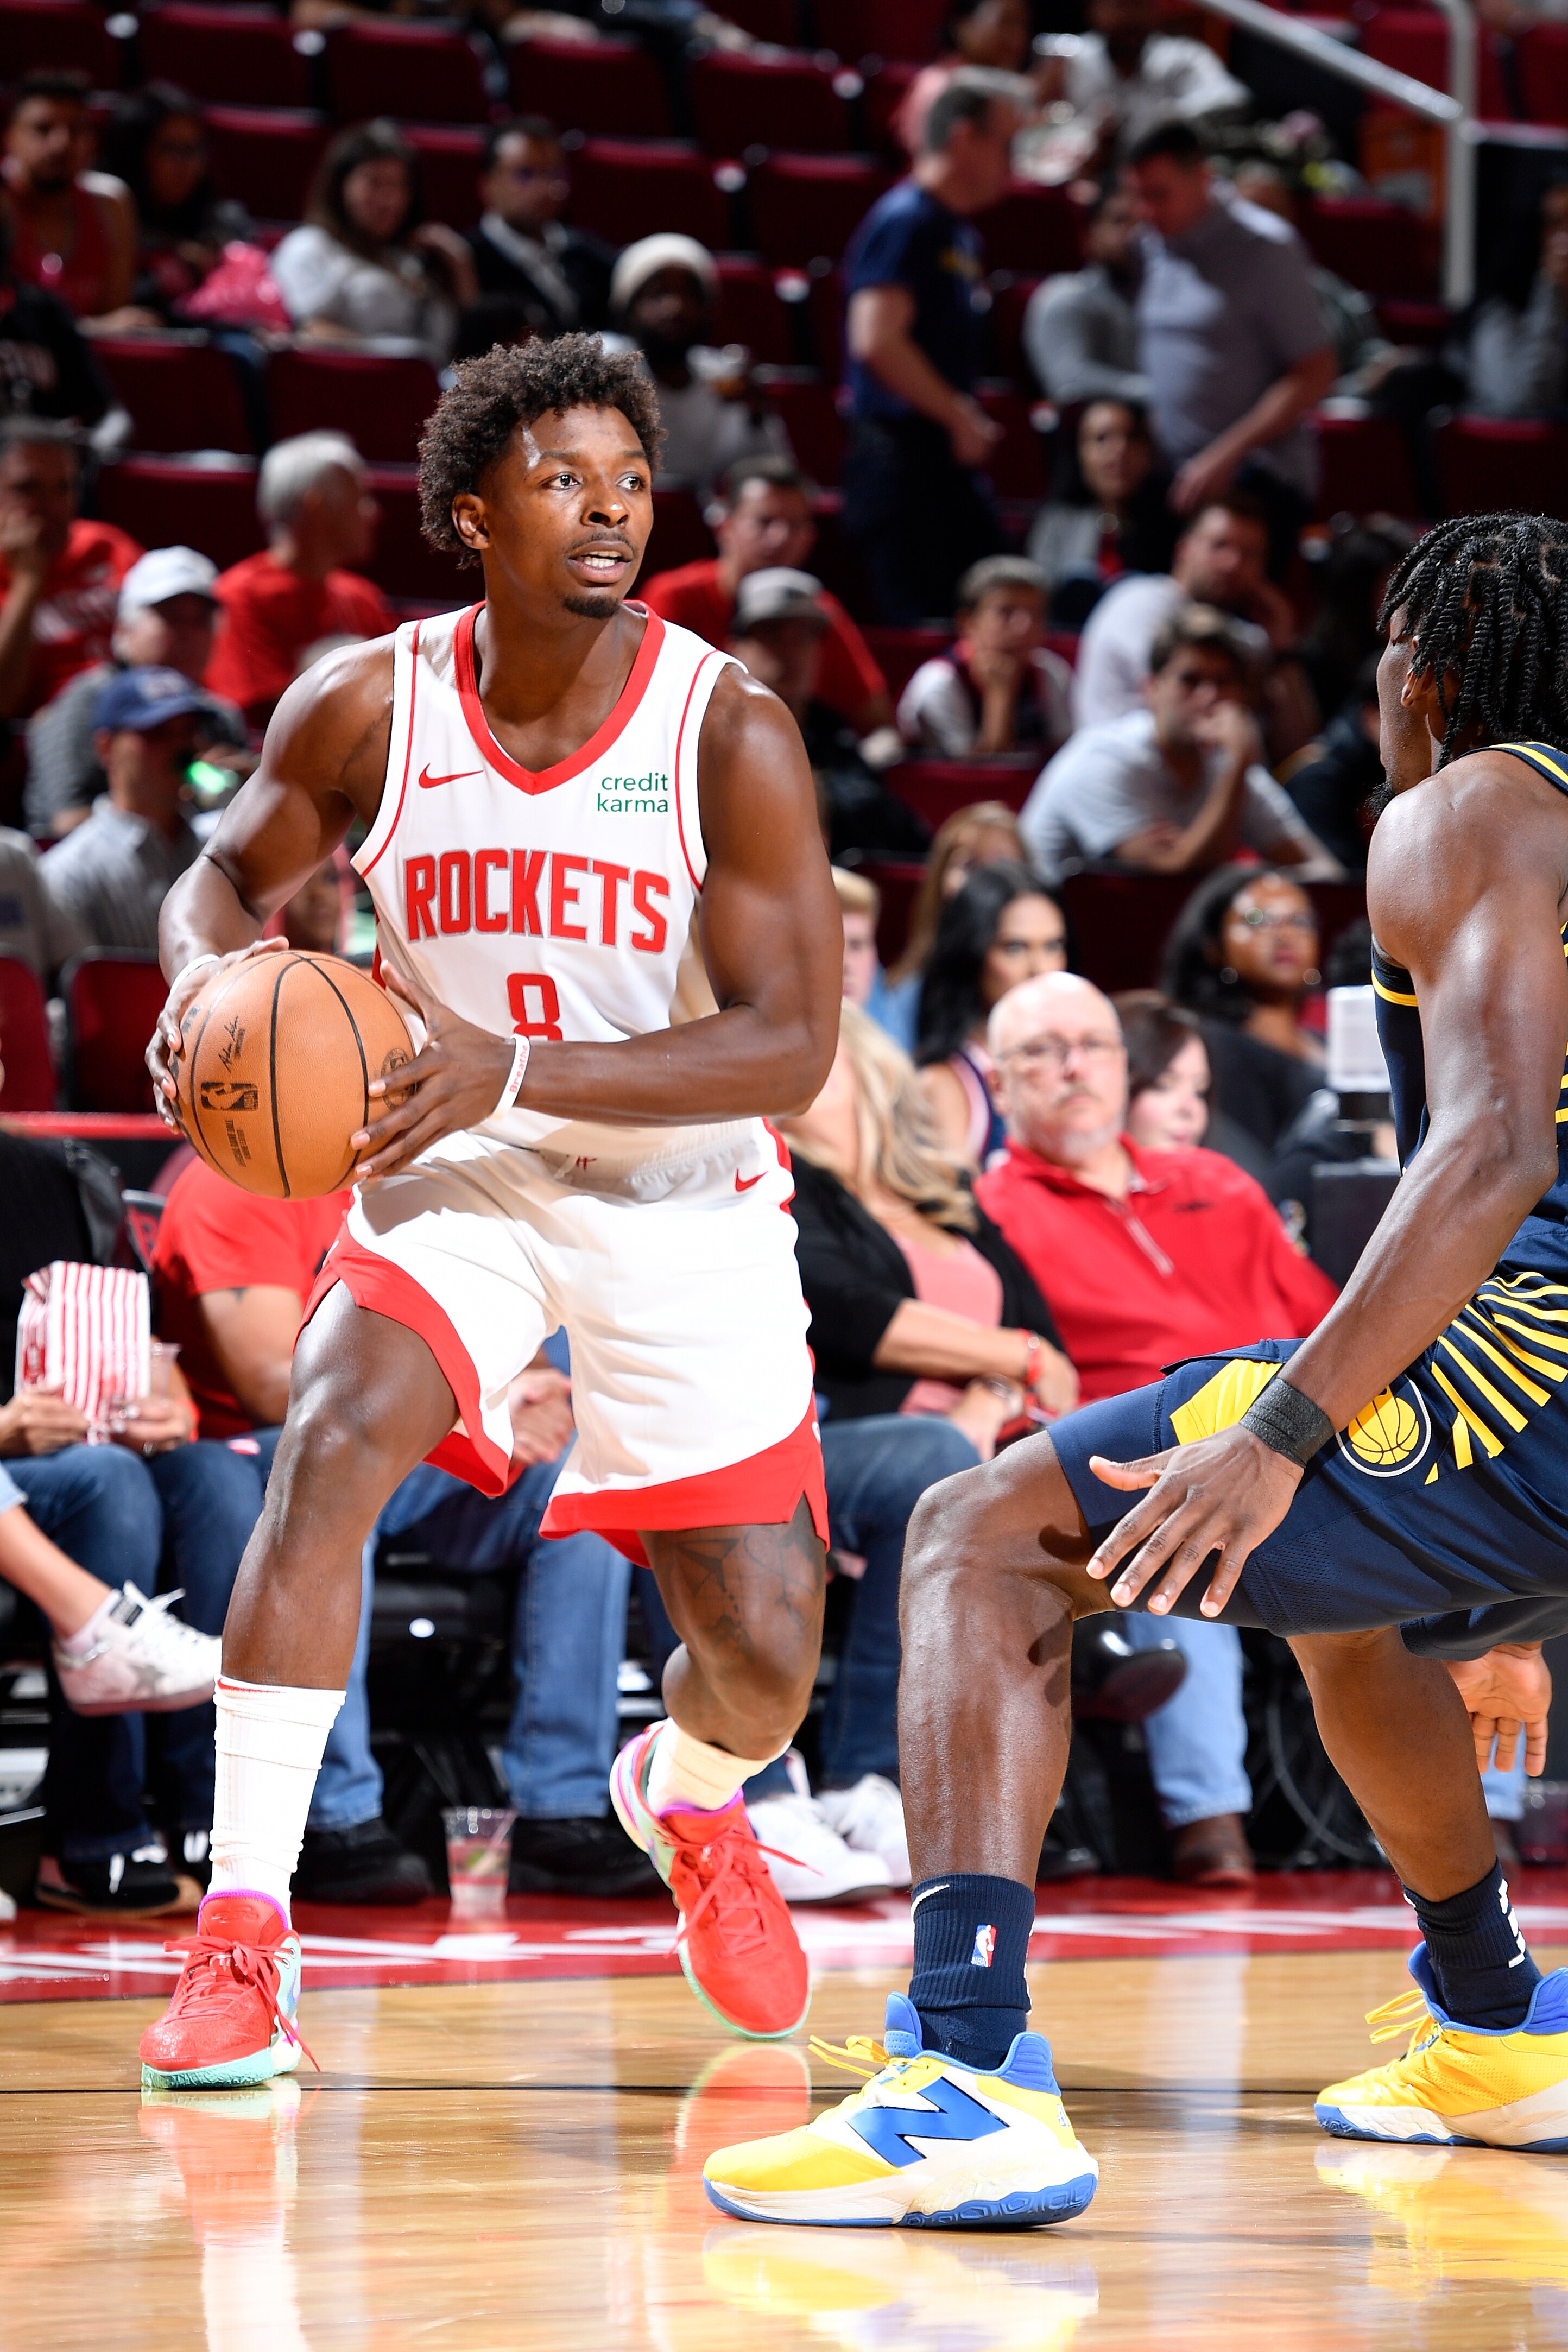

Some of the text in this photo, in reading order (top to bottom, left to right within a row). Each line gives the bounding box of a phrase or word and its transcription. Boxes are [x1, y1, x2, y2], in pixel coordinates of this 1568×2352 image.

[597, 793, 668, 813] karma
[602, 772, 668, 791] credit
[403, 847, 671, 954] ROCKETS
[506, 972, 563, 1041] 8
[509, 1045, 528, 1093] Breathe
